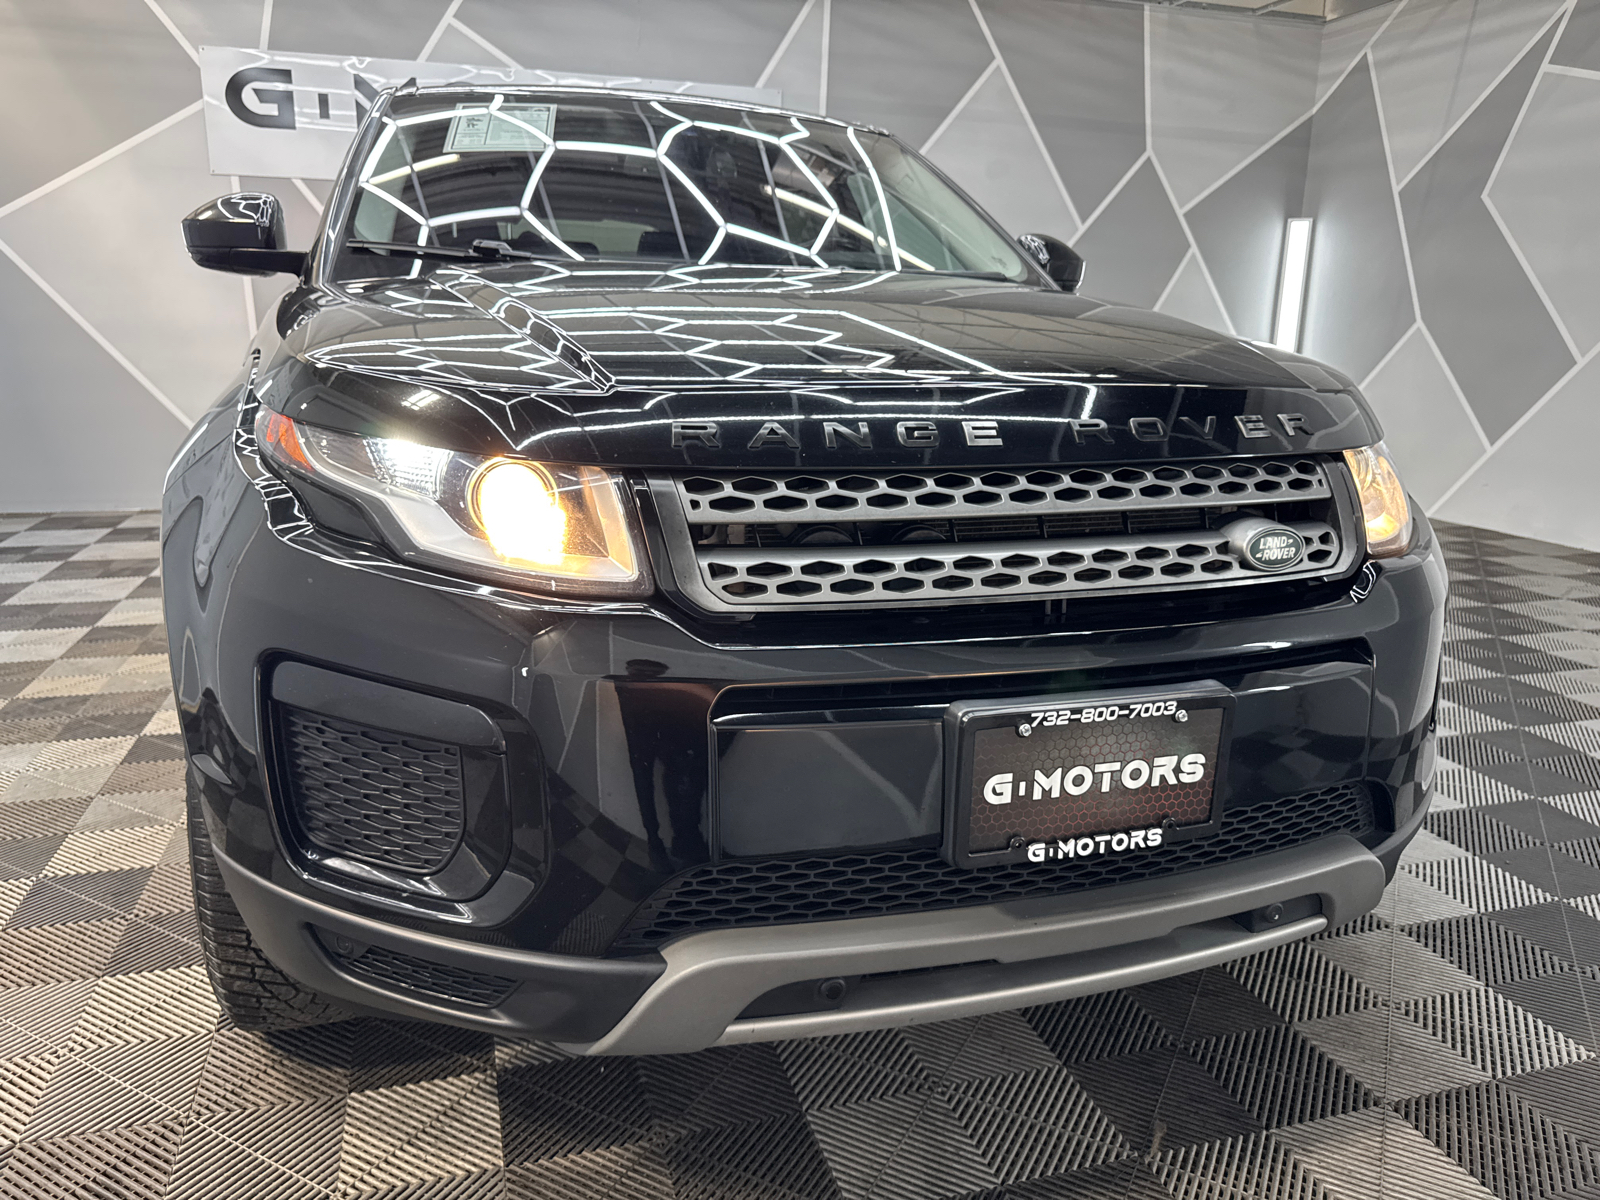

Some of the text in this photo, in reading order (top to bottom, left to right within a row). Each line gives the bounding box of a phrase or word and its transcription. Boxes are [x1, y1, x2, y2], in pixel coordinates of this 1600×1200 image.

[671, 413, 1315, 449] RANGE ROVER
[1260, 536, 1287, 549] LAND
[1262, 547, 1296, 560] ROVER
[1030, 700, 1177, 728] 732-800-7003
